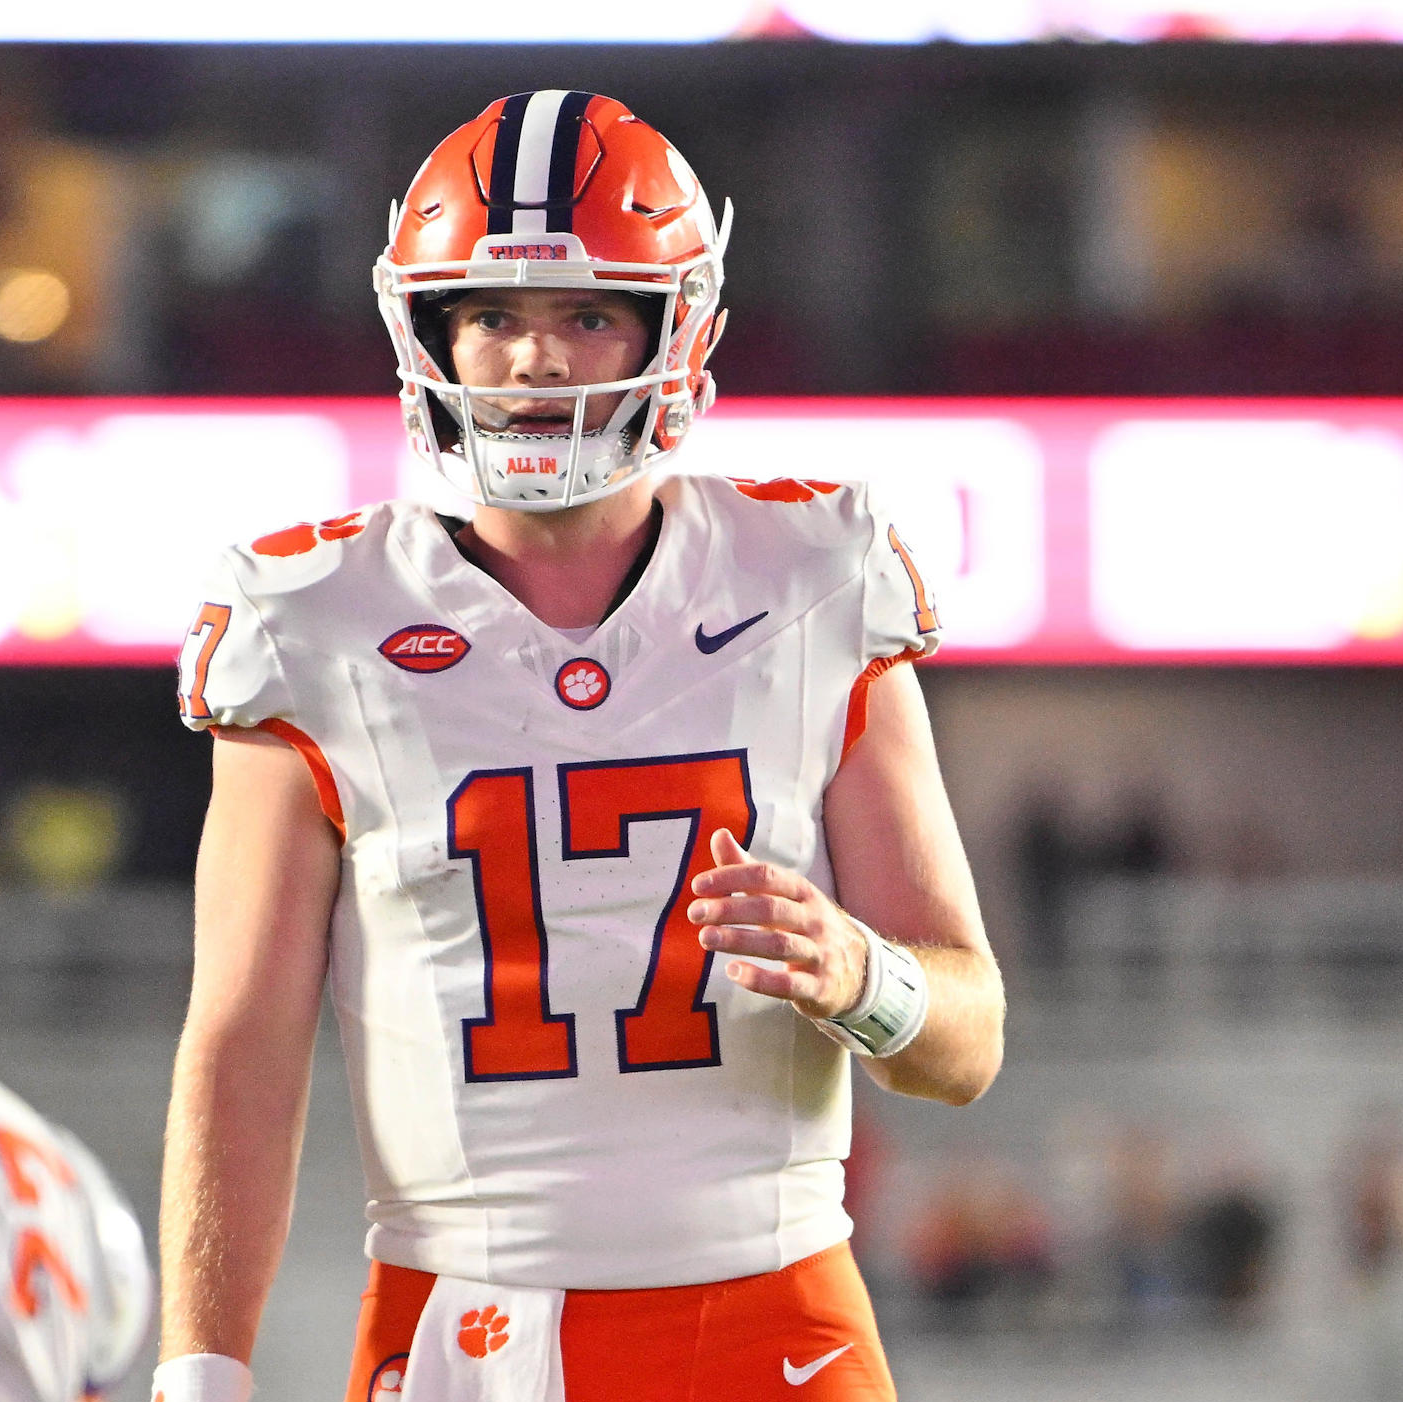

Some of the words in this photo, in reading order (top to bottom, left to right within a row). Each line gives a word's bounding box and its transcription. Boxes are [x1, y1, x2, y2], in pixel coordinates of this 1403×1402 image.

[488, 244, 567, 260] TIGERS
[506, 457, 535, 475] ALL
[538, 457, 557, 474] IN
[391, 634, 457, 654] ACC
[178, 601, 232, 719] 7
[447, 748, 757, 1083] 17
